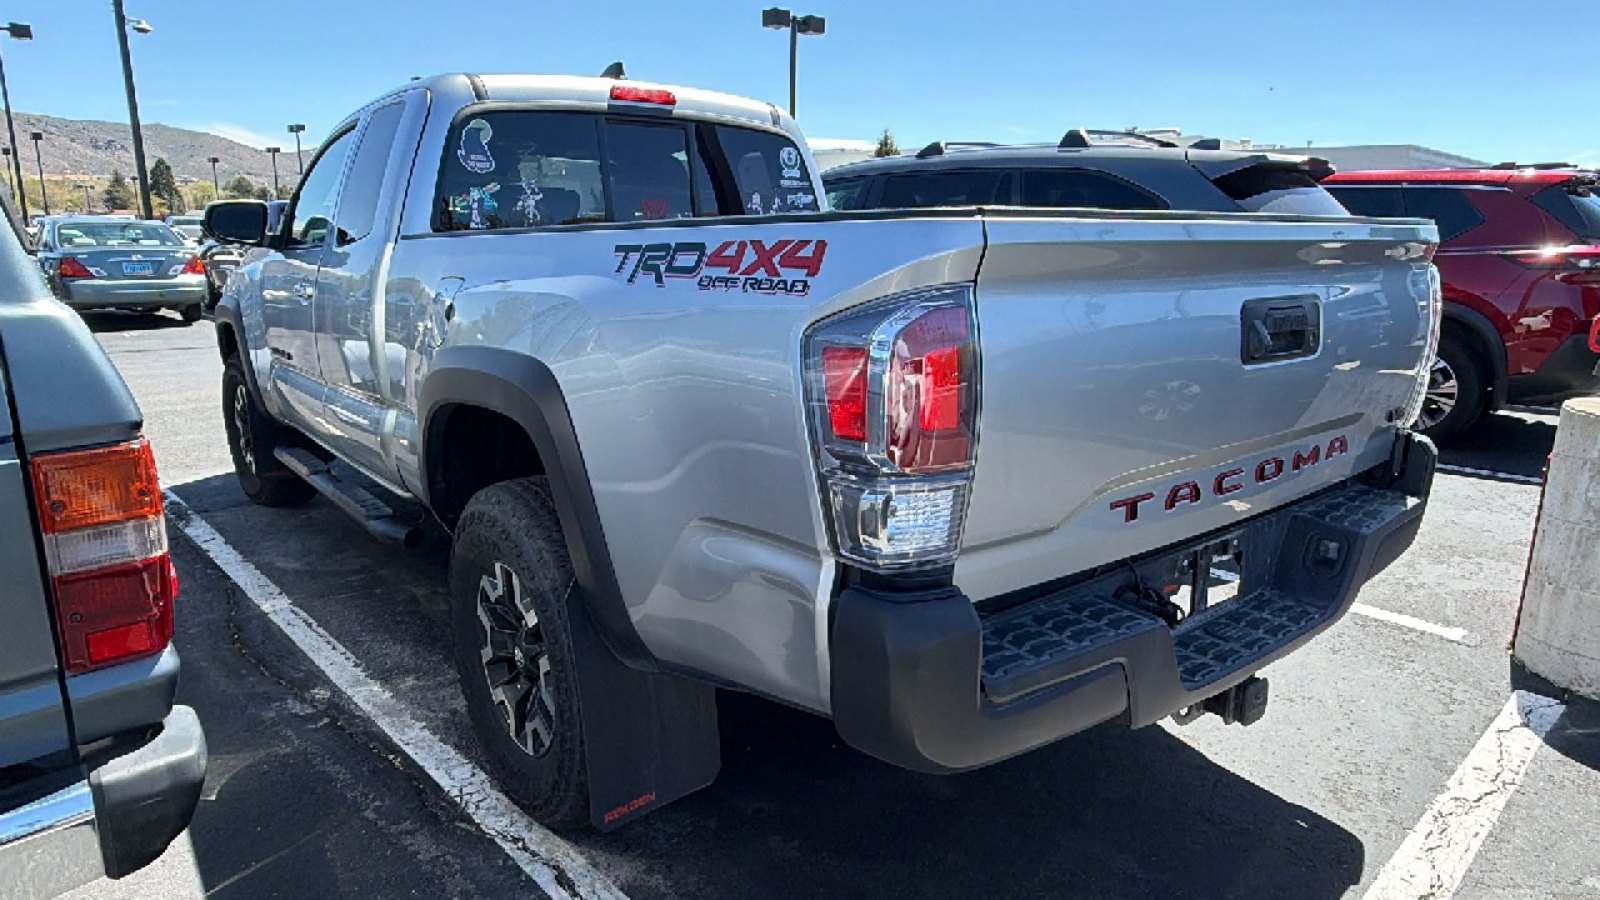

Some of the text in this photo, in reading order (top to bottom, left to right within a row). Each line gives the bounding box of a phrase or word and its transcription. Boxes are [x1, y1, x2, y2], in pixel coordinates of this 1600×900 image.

[614, 239, 828, 288] TRD 4X4
[697, 275, 810, 297] OFF ROAD
[1109, 434, 1349, 523] TACOMA
